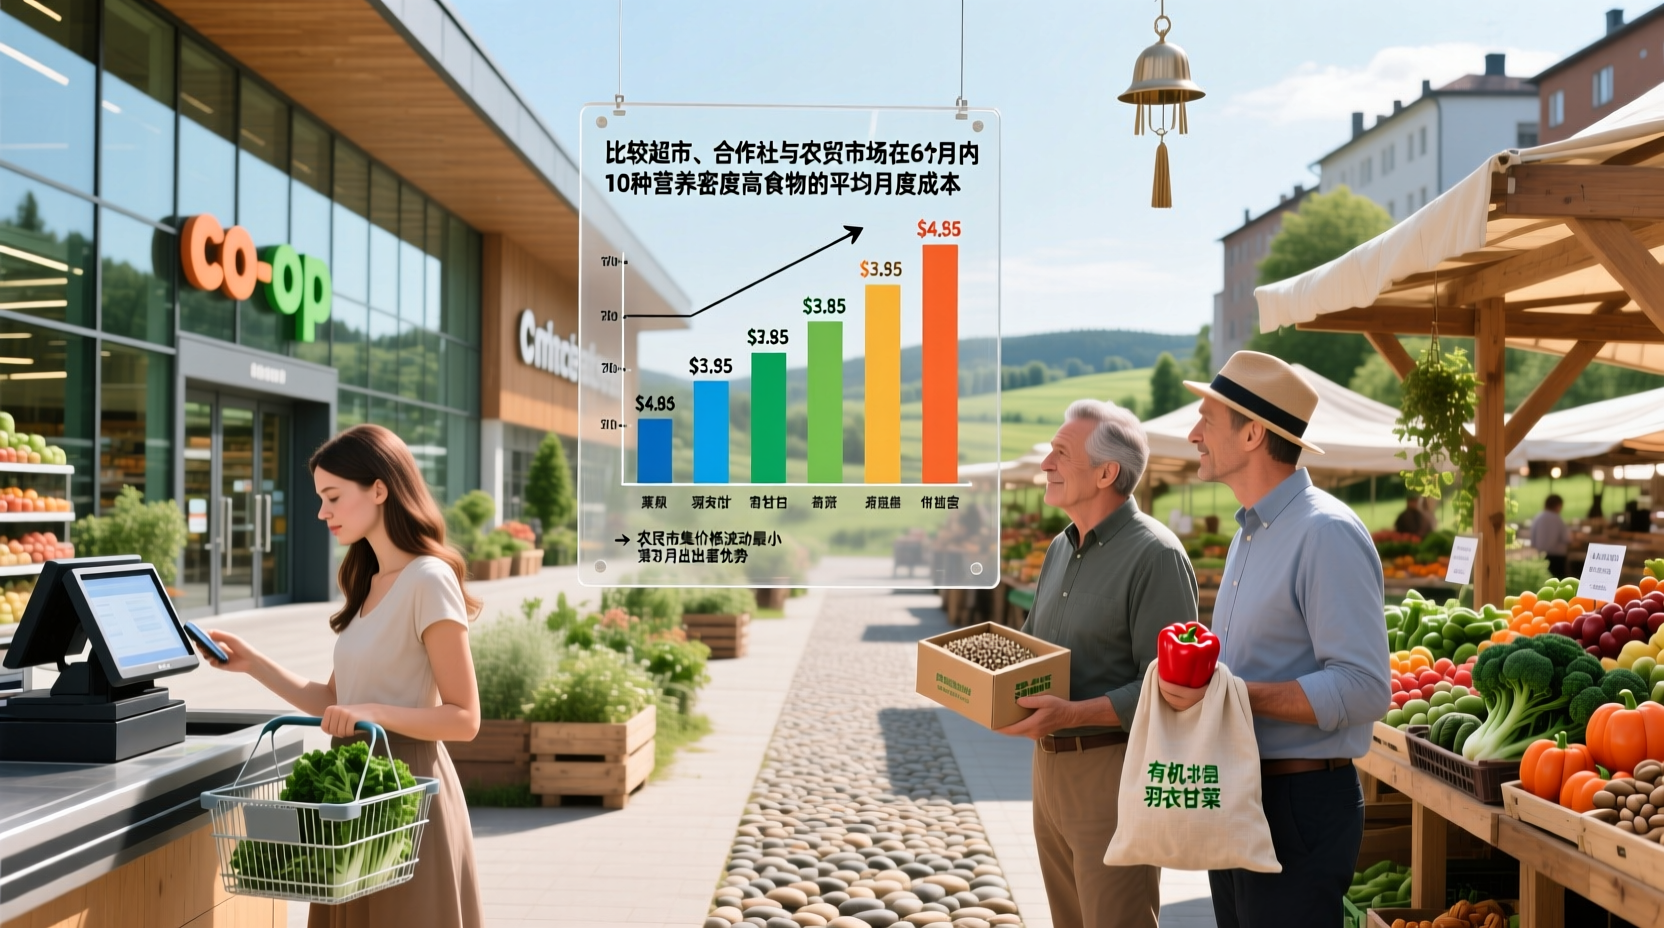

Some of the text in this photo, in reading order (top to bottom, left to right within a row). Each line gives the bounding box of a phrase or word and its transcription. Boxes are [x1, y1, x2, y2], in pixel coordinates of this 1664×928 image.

[605, 170, 961, 196] 10种营养密度高食物的平均月度成本
